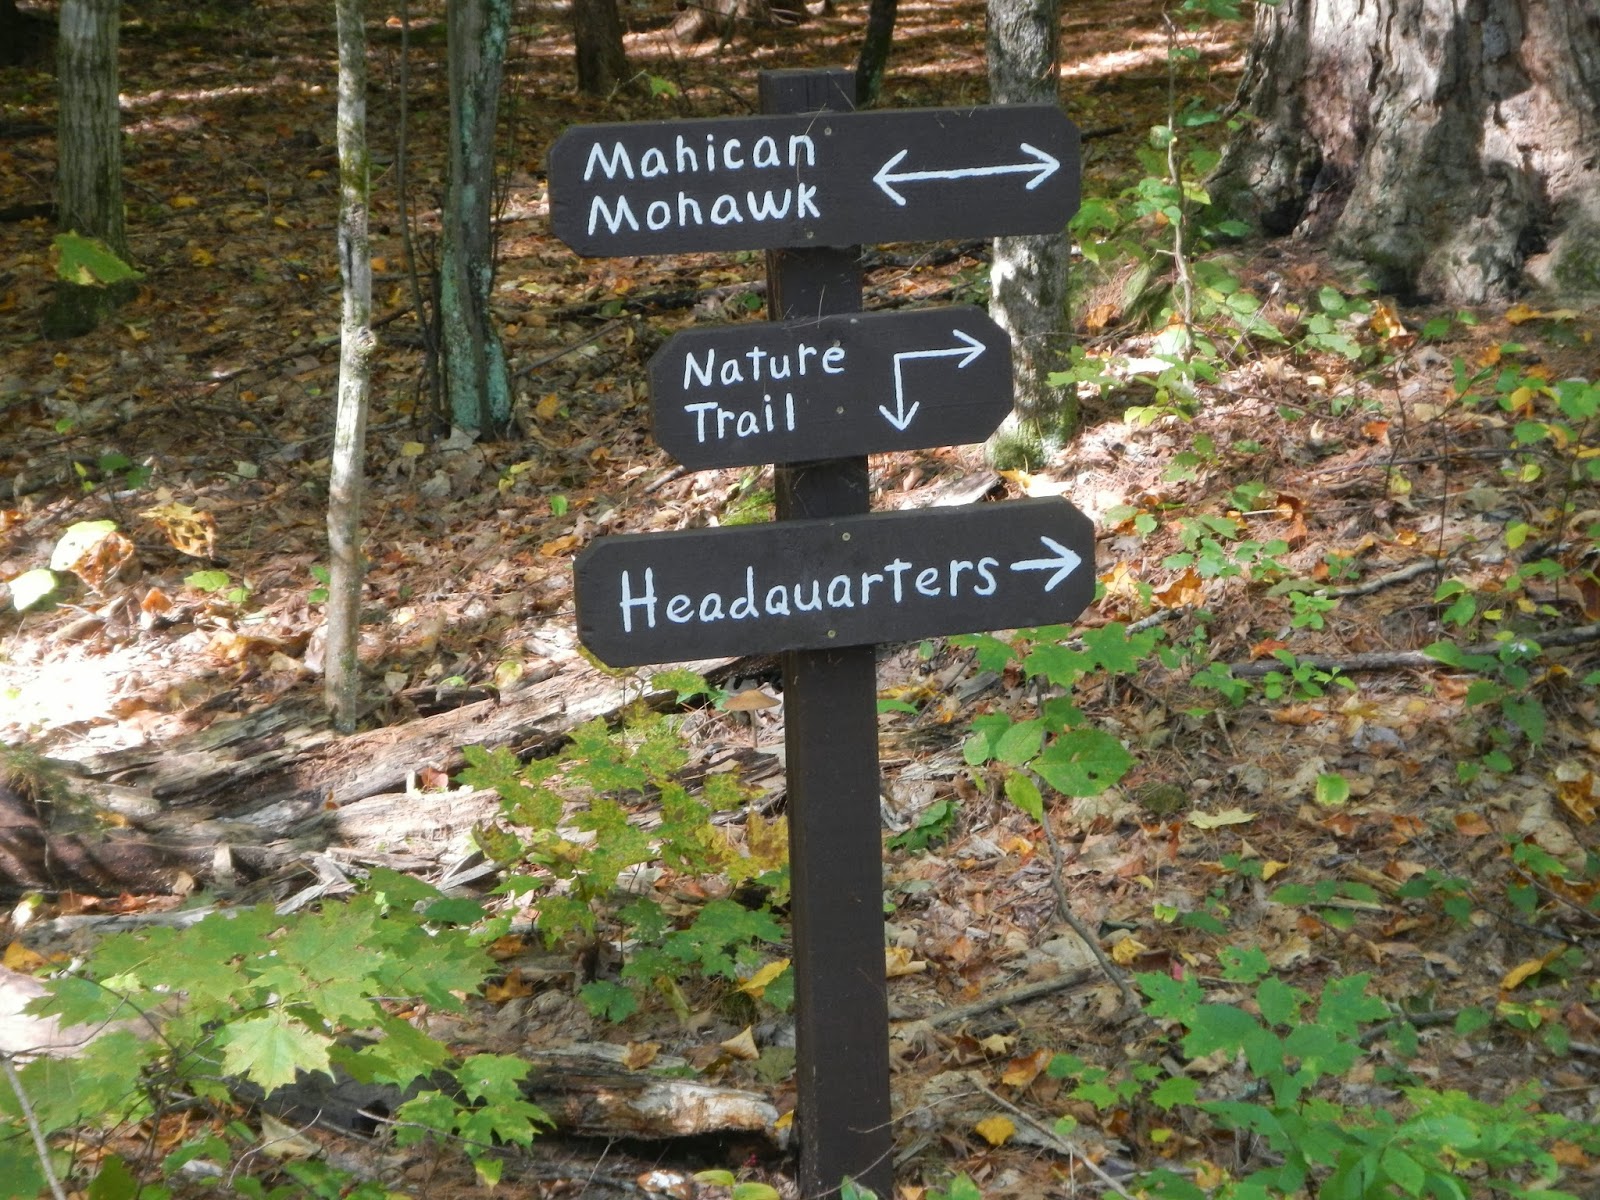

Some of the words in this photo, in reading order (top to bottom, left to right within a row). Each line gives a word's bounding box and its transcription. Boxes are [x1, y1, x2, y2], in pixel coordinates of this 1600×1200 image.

[583, 133, 816, 182] Mahican
[588, 182, 822, 236] Mohawk
[683, 342, 846, 390] Nature
[684, 393, 796, 443] Trail
